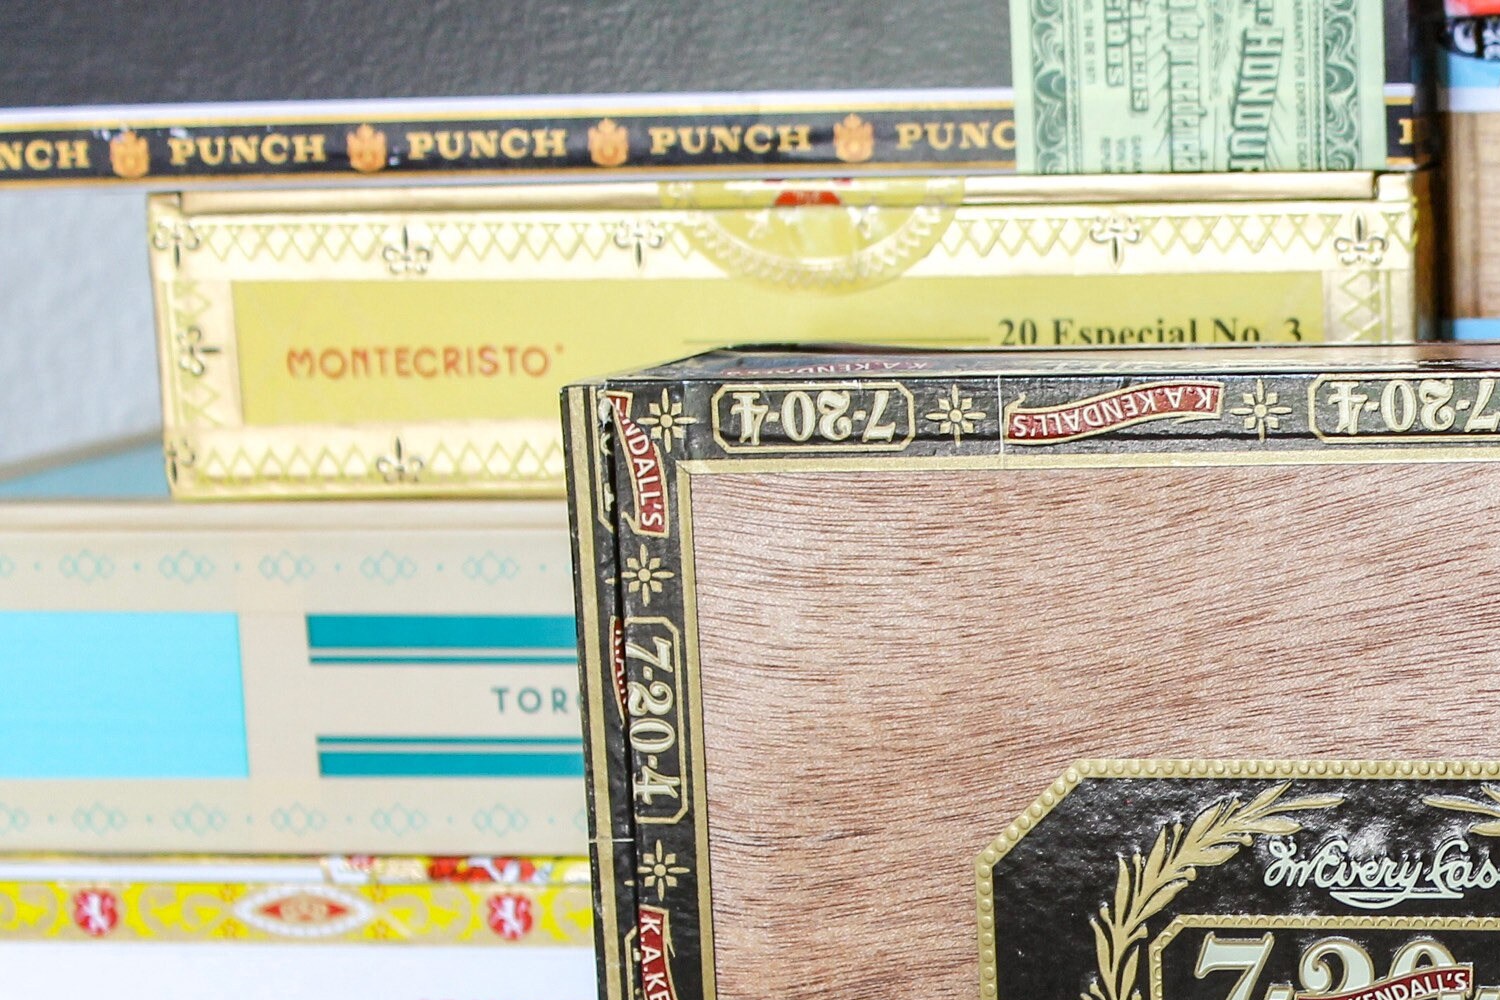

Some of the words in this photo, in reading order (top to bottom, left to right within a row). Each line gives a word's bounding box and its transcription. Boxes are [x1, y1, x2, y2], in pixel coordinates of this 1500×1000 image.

[168, 134, 327, 166] PUNCH
[406, 128, 568, 160] PUNCH
[650, 124, 812, 155] PUNCH
[999, 317, 1038, 345] 20
[1051, 317, 1197, 345] Especial
[1283, 317, 1303, 342] 3
[286, 343, 553, 379] MONTECRISTO
[731, 388, 897, 447] 7-20-4
[1014, 383, 1216, 440] K.A.KENDALL'S
[491, 686, 583, 713] TOR
[627, 636, 681, 806] 7-20-4
